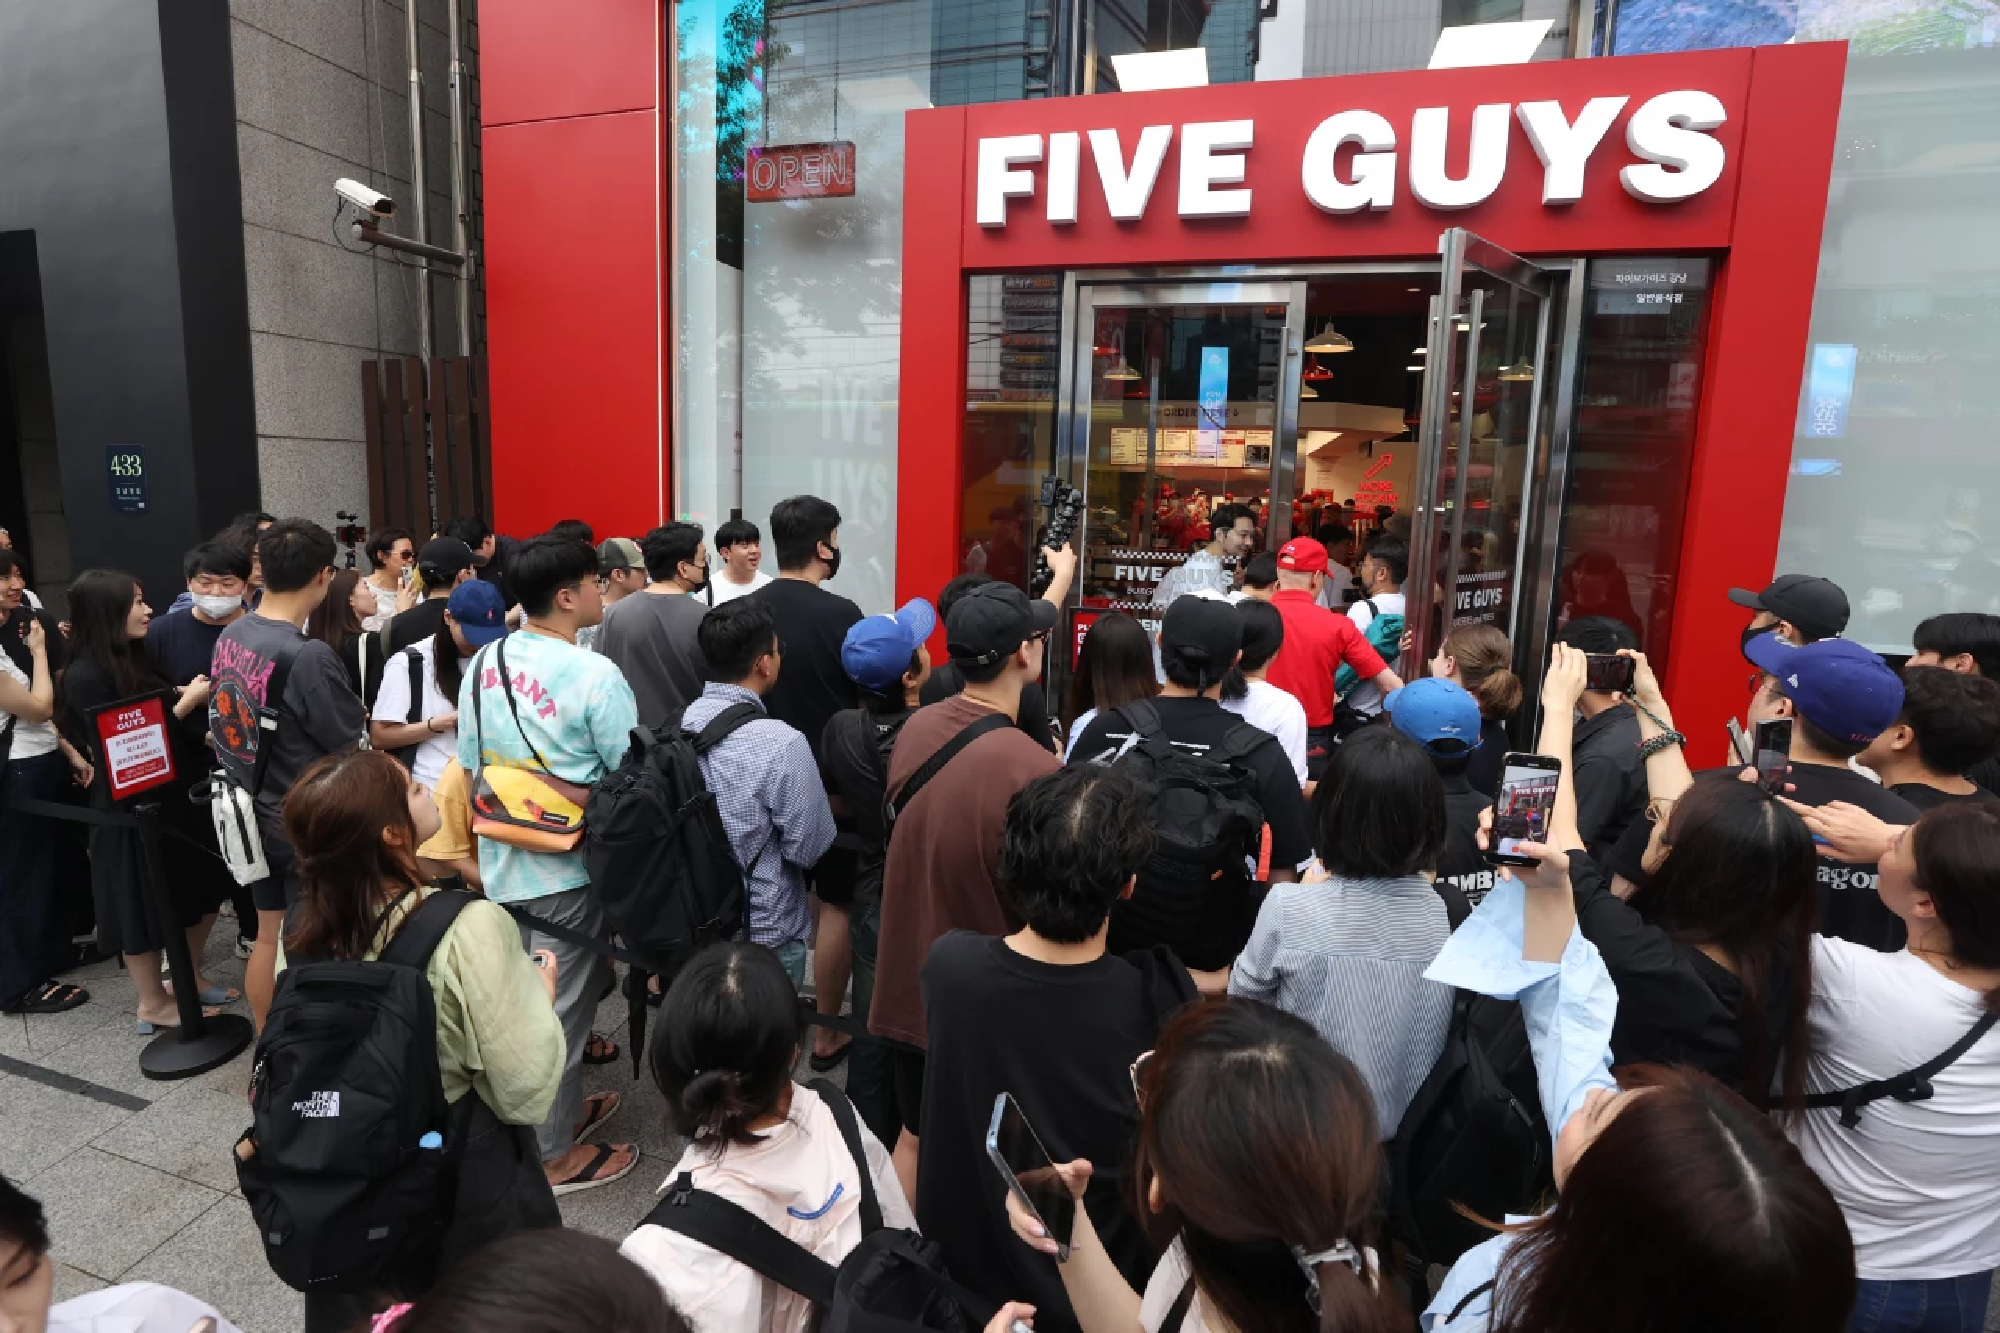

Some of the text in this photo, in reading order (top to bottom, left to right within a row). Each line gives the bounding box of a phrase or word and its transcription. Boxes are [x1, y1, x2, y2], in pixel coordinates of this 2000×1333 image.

[976, 90, 1727, 228] FIVE GUYS
[752, 151, 846, 191] OPEN
[110, 454, 142, 477] 433
[1358, 481, 1393, 492] MORE
[1115, 565, 1235, 586] FIVE GUYS
[1473, 587, 1503, 608] GUYS
[118, 708, 142, 721] FIVE
